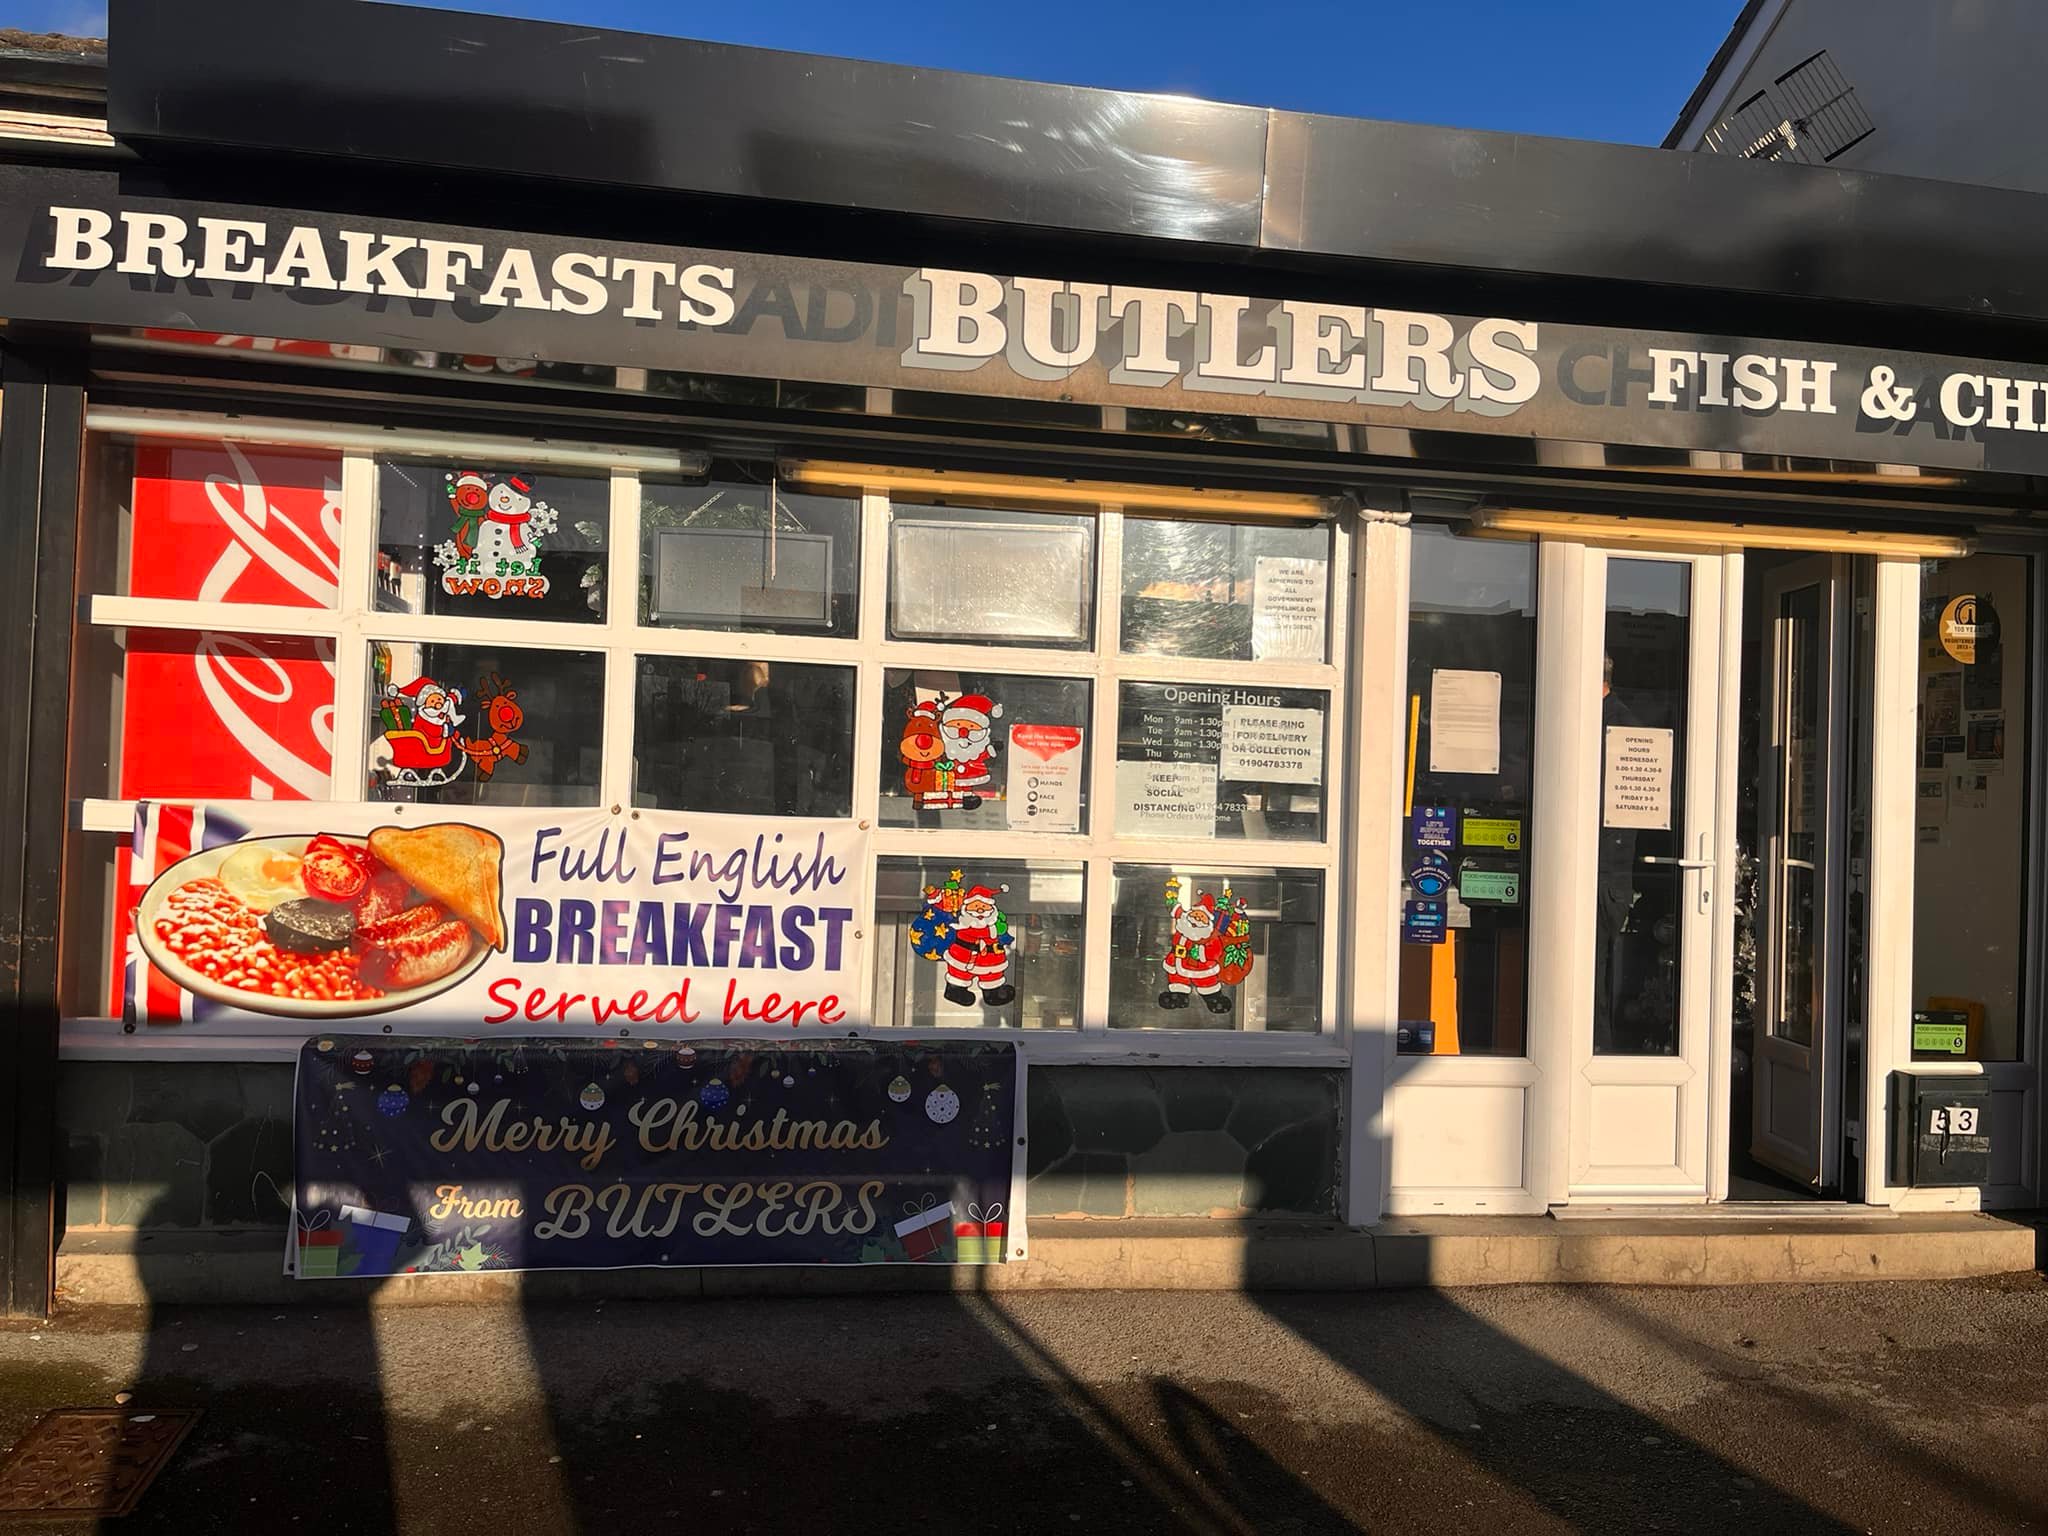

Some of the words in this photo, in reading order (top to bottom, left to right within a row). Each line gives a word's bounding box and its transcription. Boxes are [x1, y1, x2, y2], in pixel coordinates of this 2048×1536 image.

[45, 206, 735, 327] BREAKFASTS
[902, 267, 1541, 416] BUTLERS
[1648, 348, 1837, 414] FISH
[1861, 365, 1917, 421] &
[1164, 687, 1231, 707] Opening
[1234, 690, 1281, 707] Hours
[1143, 714, 1163, 723] Mon
[1174, 716, 1193, 725] 9am
[1240, 718, 1278, 727] PLEASE
[1280, 720, 1304, 729] RING
[1147, 726, 1163, 734] Tue
[1174, 728, 1192, 736] 9am
[1237, 732, 1257, 740] FOR
[1260, 733, 1308, 743] DELIVERY
[1142, 737, 1162, 746] Wed
[1173, 739, 1192, 747] 9am
[1145, 748, 1162, 757] Thu
[1173, 750, 1191, 759] 9am
[1249, 746, 1311, 756] COLLECTION
[1146, 789, 1183, 797] SOCIAL
[1133, 803, 1195, 813] DISTANCING
[531, 825, 636, 885] Full
[650, 828, 847, 902] English
[512, 898, 853, 972] BREAKFAST
[484, 976, 700, 1027] Served
[723, 979, 847, 1026] here
[429, 1097, 615, 1170] Merry
[628, 1096, 890, 1152] Christmas
[430, 1184, 523, 1221] From
[534, 1180, 884, 1240] BUTLERS
